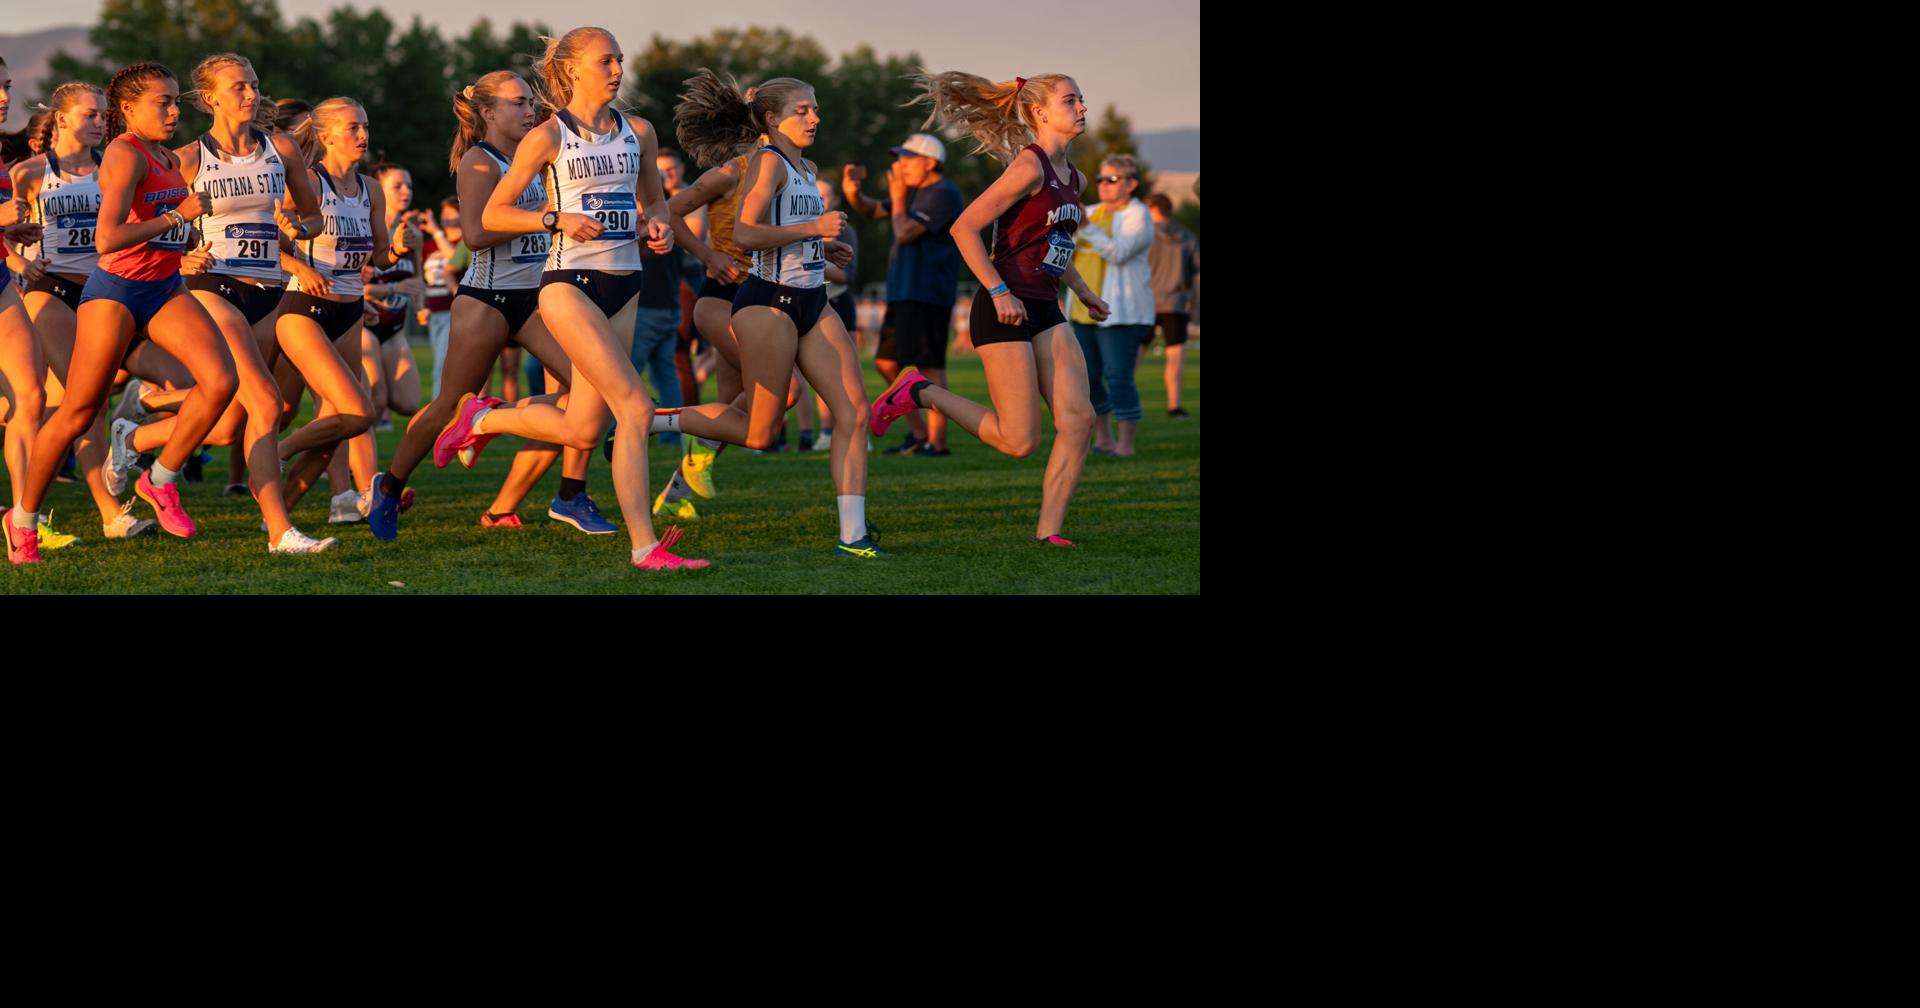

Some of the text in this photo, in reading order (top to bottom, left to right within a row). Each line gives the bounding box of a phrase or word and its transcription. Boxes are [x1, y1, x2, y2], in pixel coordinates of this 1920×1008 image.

[567, 155, 614, 180] MONTANA
[144, 188, 179, 203] BOISE
[204, 176, 254, 198] MONTANA
[44, 195, 90, 216] MONTANA
[595, 211, 629, 230] 290
[238, 239, 268, 258] 291
[520, 235, 546, 254] 283
[343, 252, 367, 269] 287
